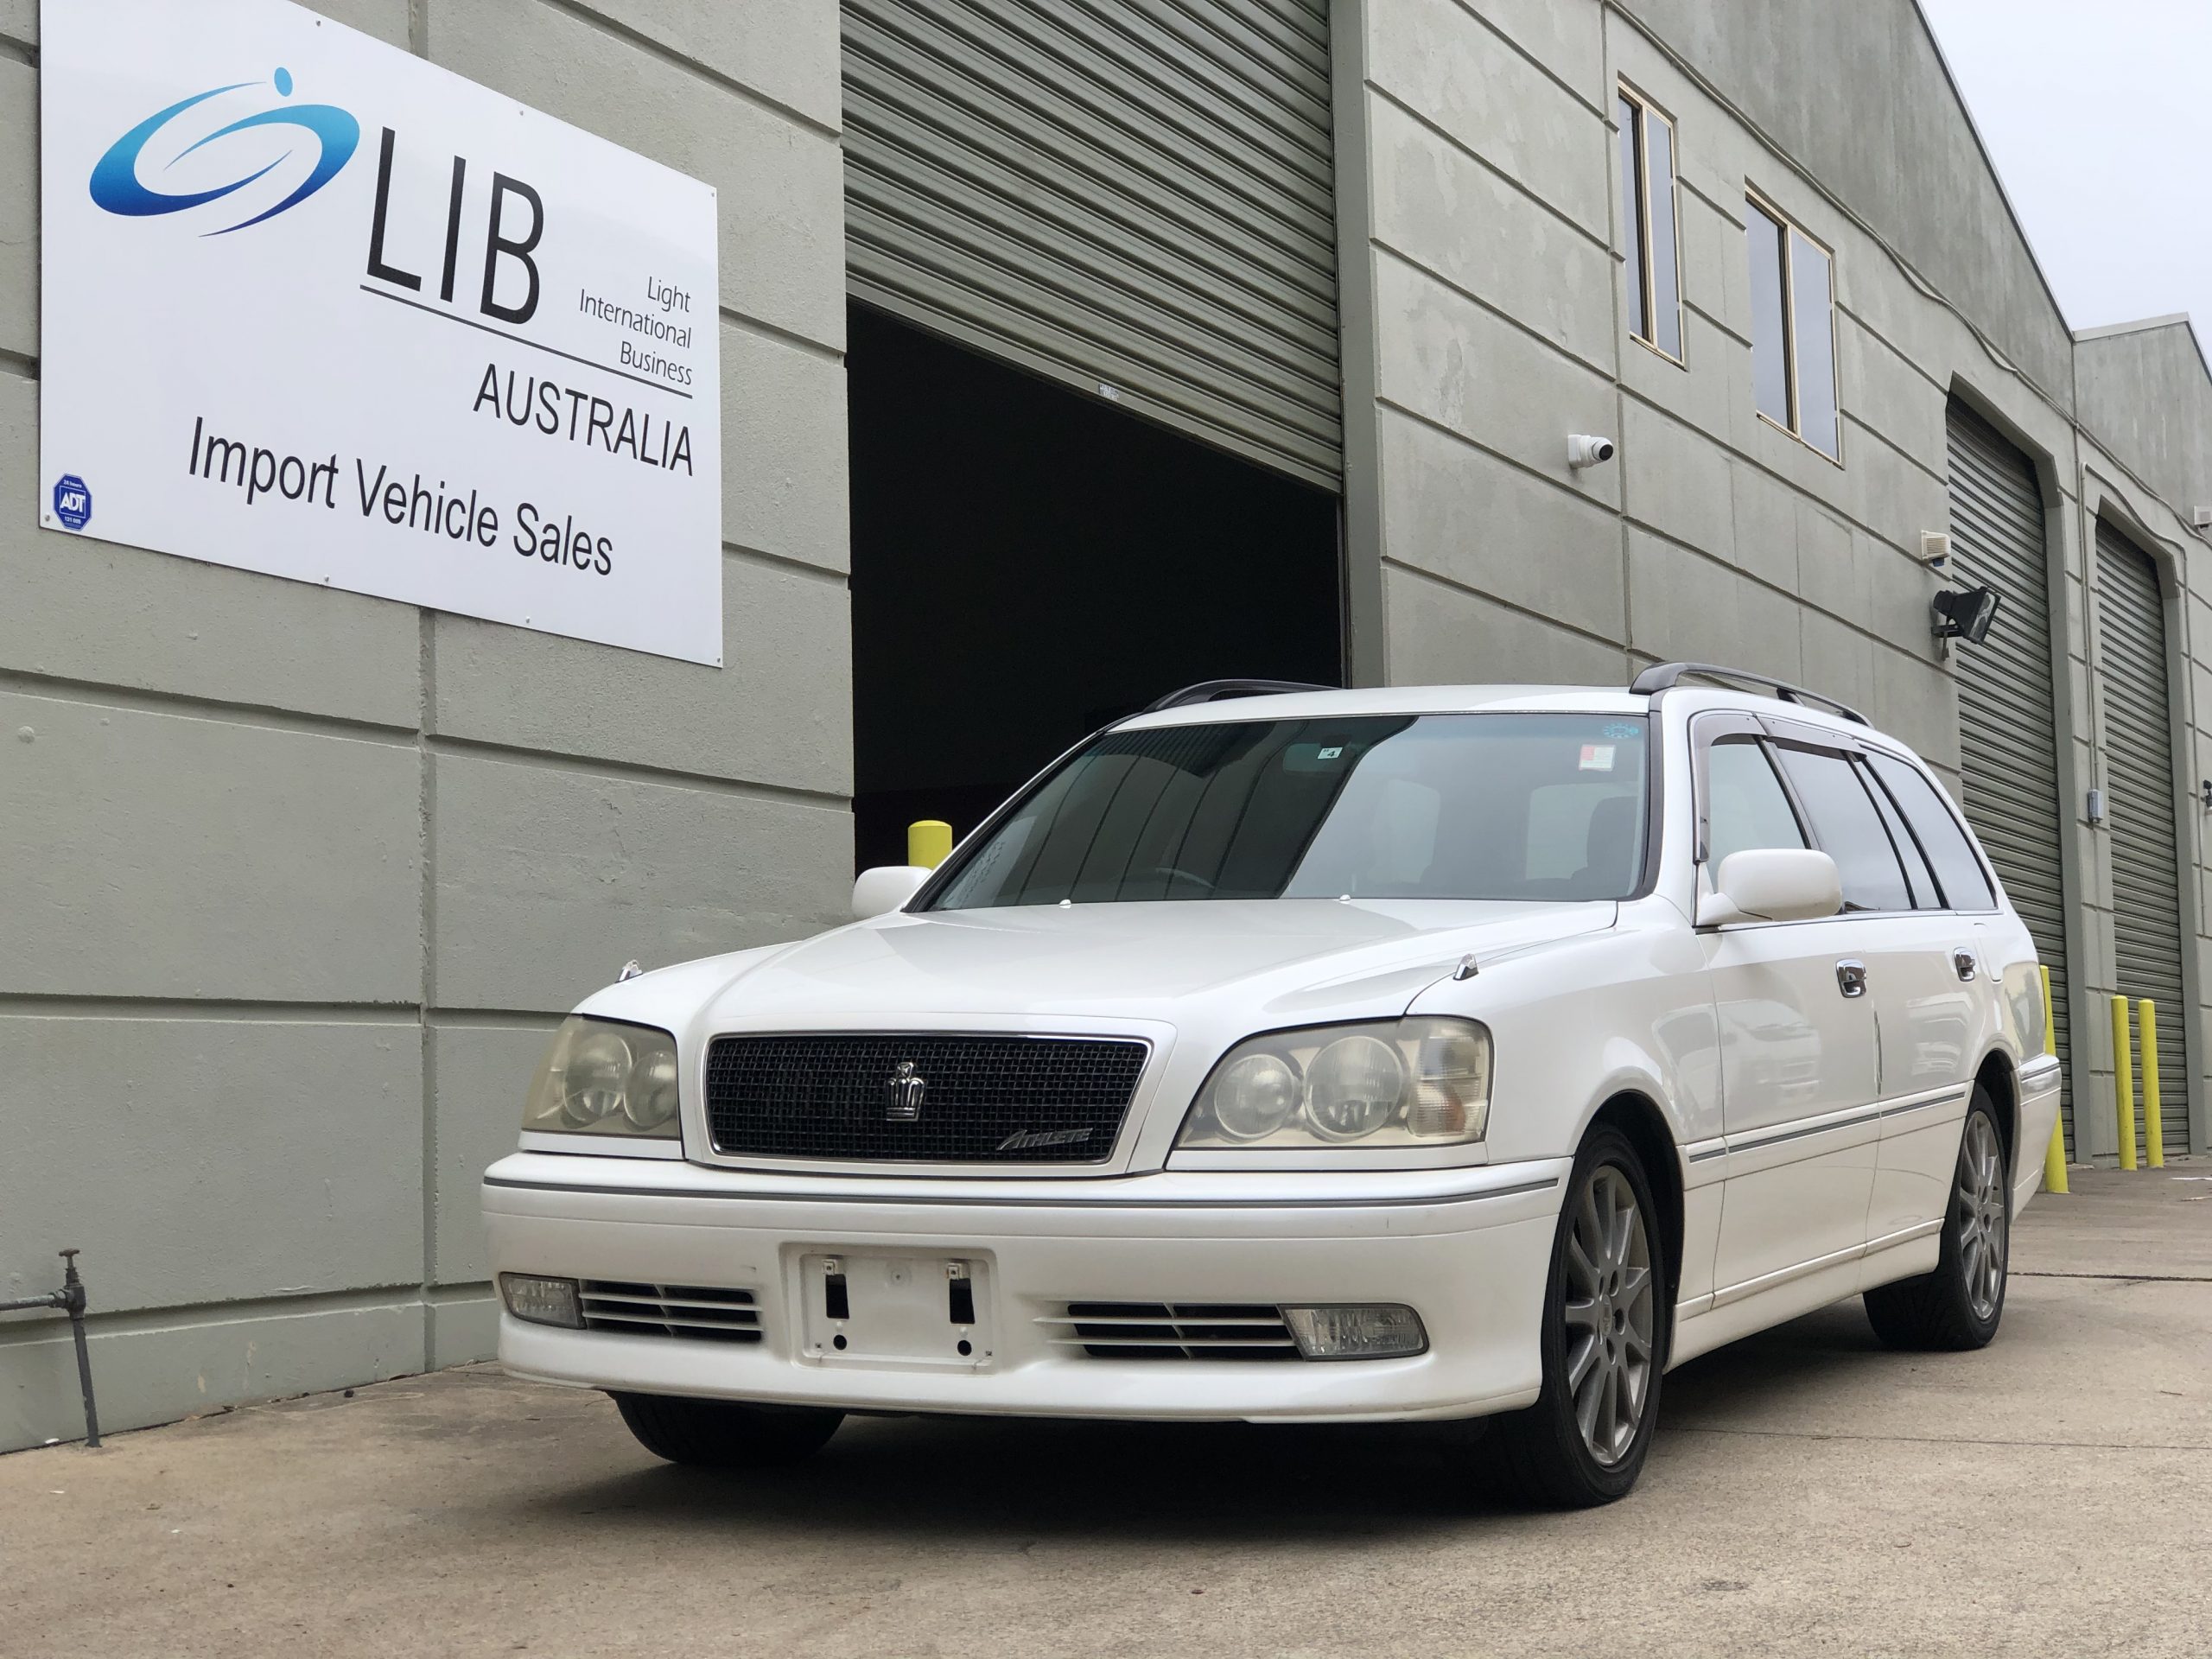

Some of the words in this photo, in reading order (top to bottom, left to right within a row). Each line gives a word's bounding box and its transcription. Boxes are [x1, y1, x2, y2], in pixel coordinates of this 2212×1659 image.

[367, 127, 544, 324] LIB
[581, 289, 692, 348] International
[648, 276, 691, 312] Light
[621, 341, 693, 385] Business
[474, 364, 693, 477] AUSTRALIA
[60, 492, 86, 512] ADT
[190, 416, 340, 508] Import
[357, 459, 499, 548] Vehicle
[514, 503, 613, 576] Sales
